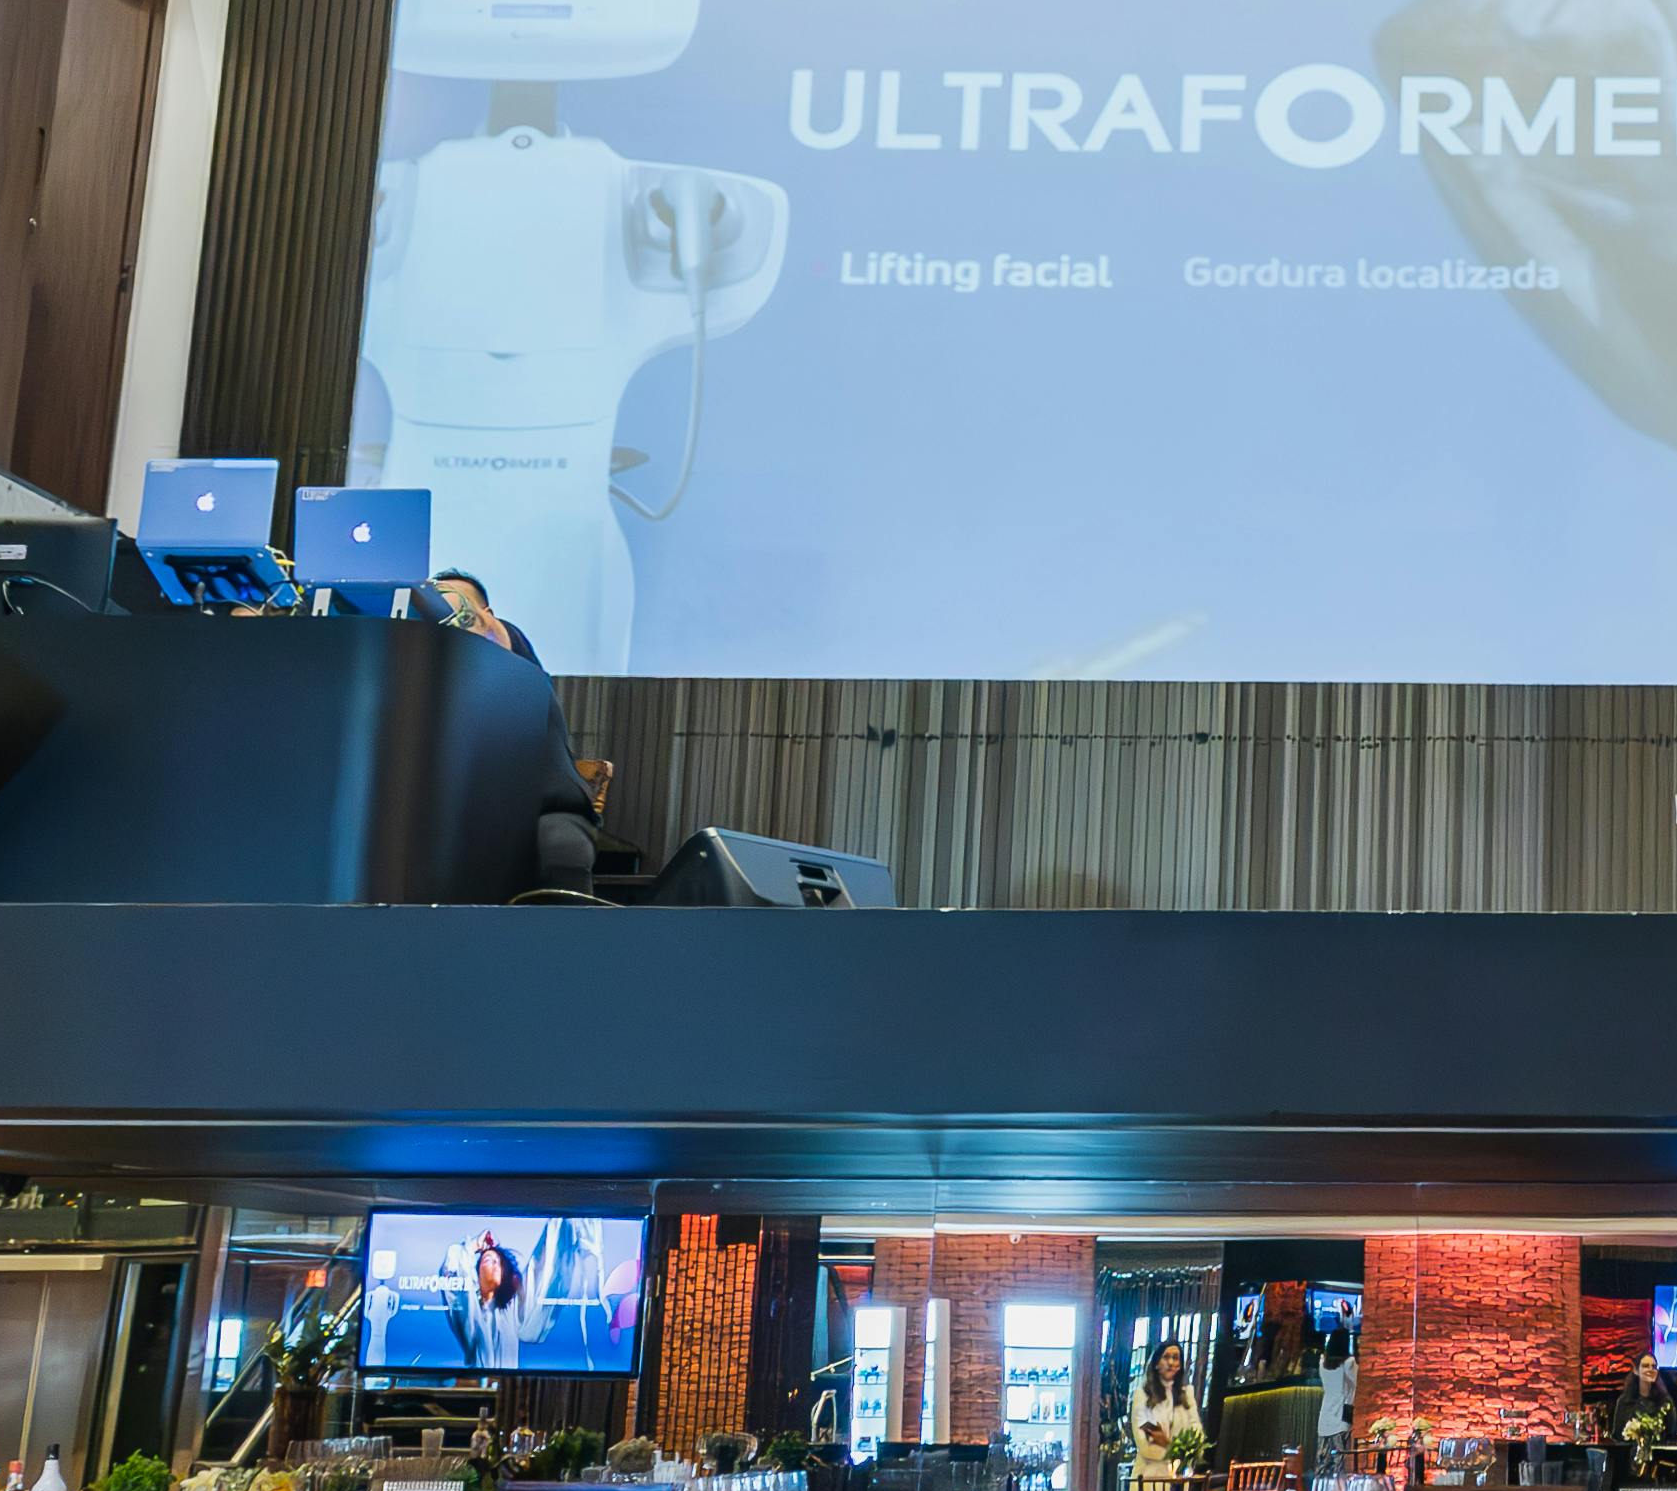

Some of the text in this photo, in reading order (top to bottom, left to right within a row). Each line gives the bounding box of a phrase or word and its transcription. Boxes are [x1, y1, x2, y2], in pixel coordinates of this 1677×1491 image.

[839, 251, 1114, 293] Lifting facial
[1183, 256, 1561, 291] Gordura localizada
